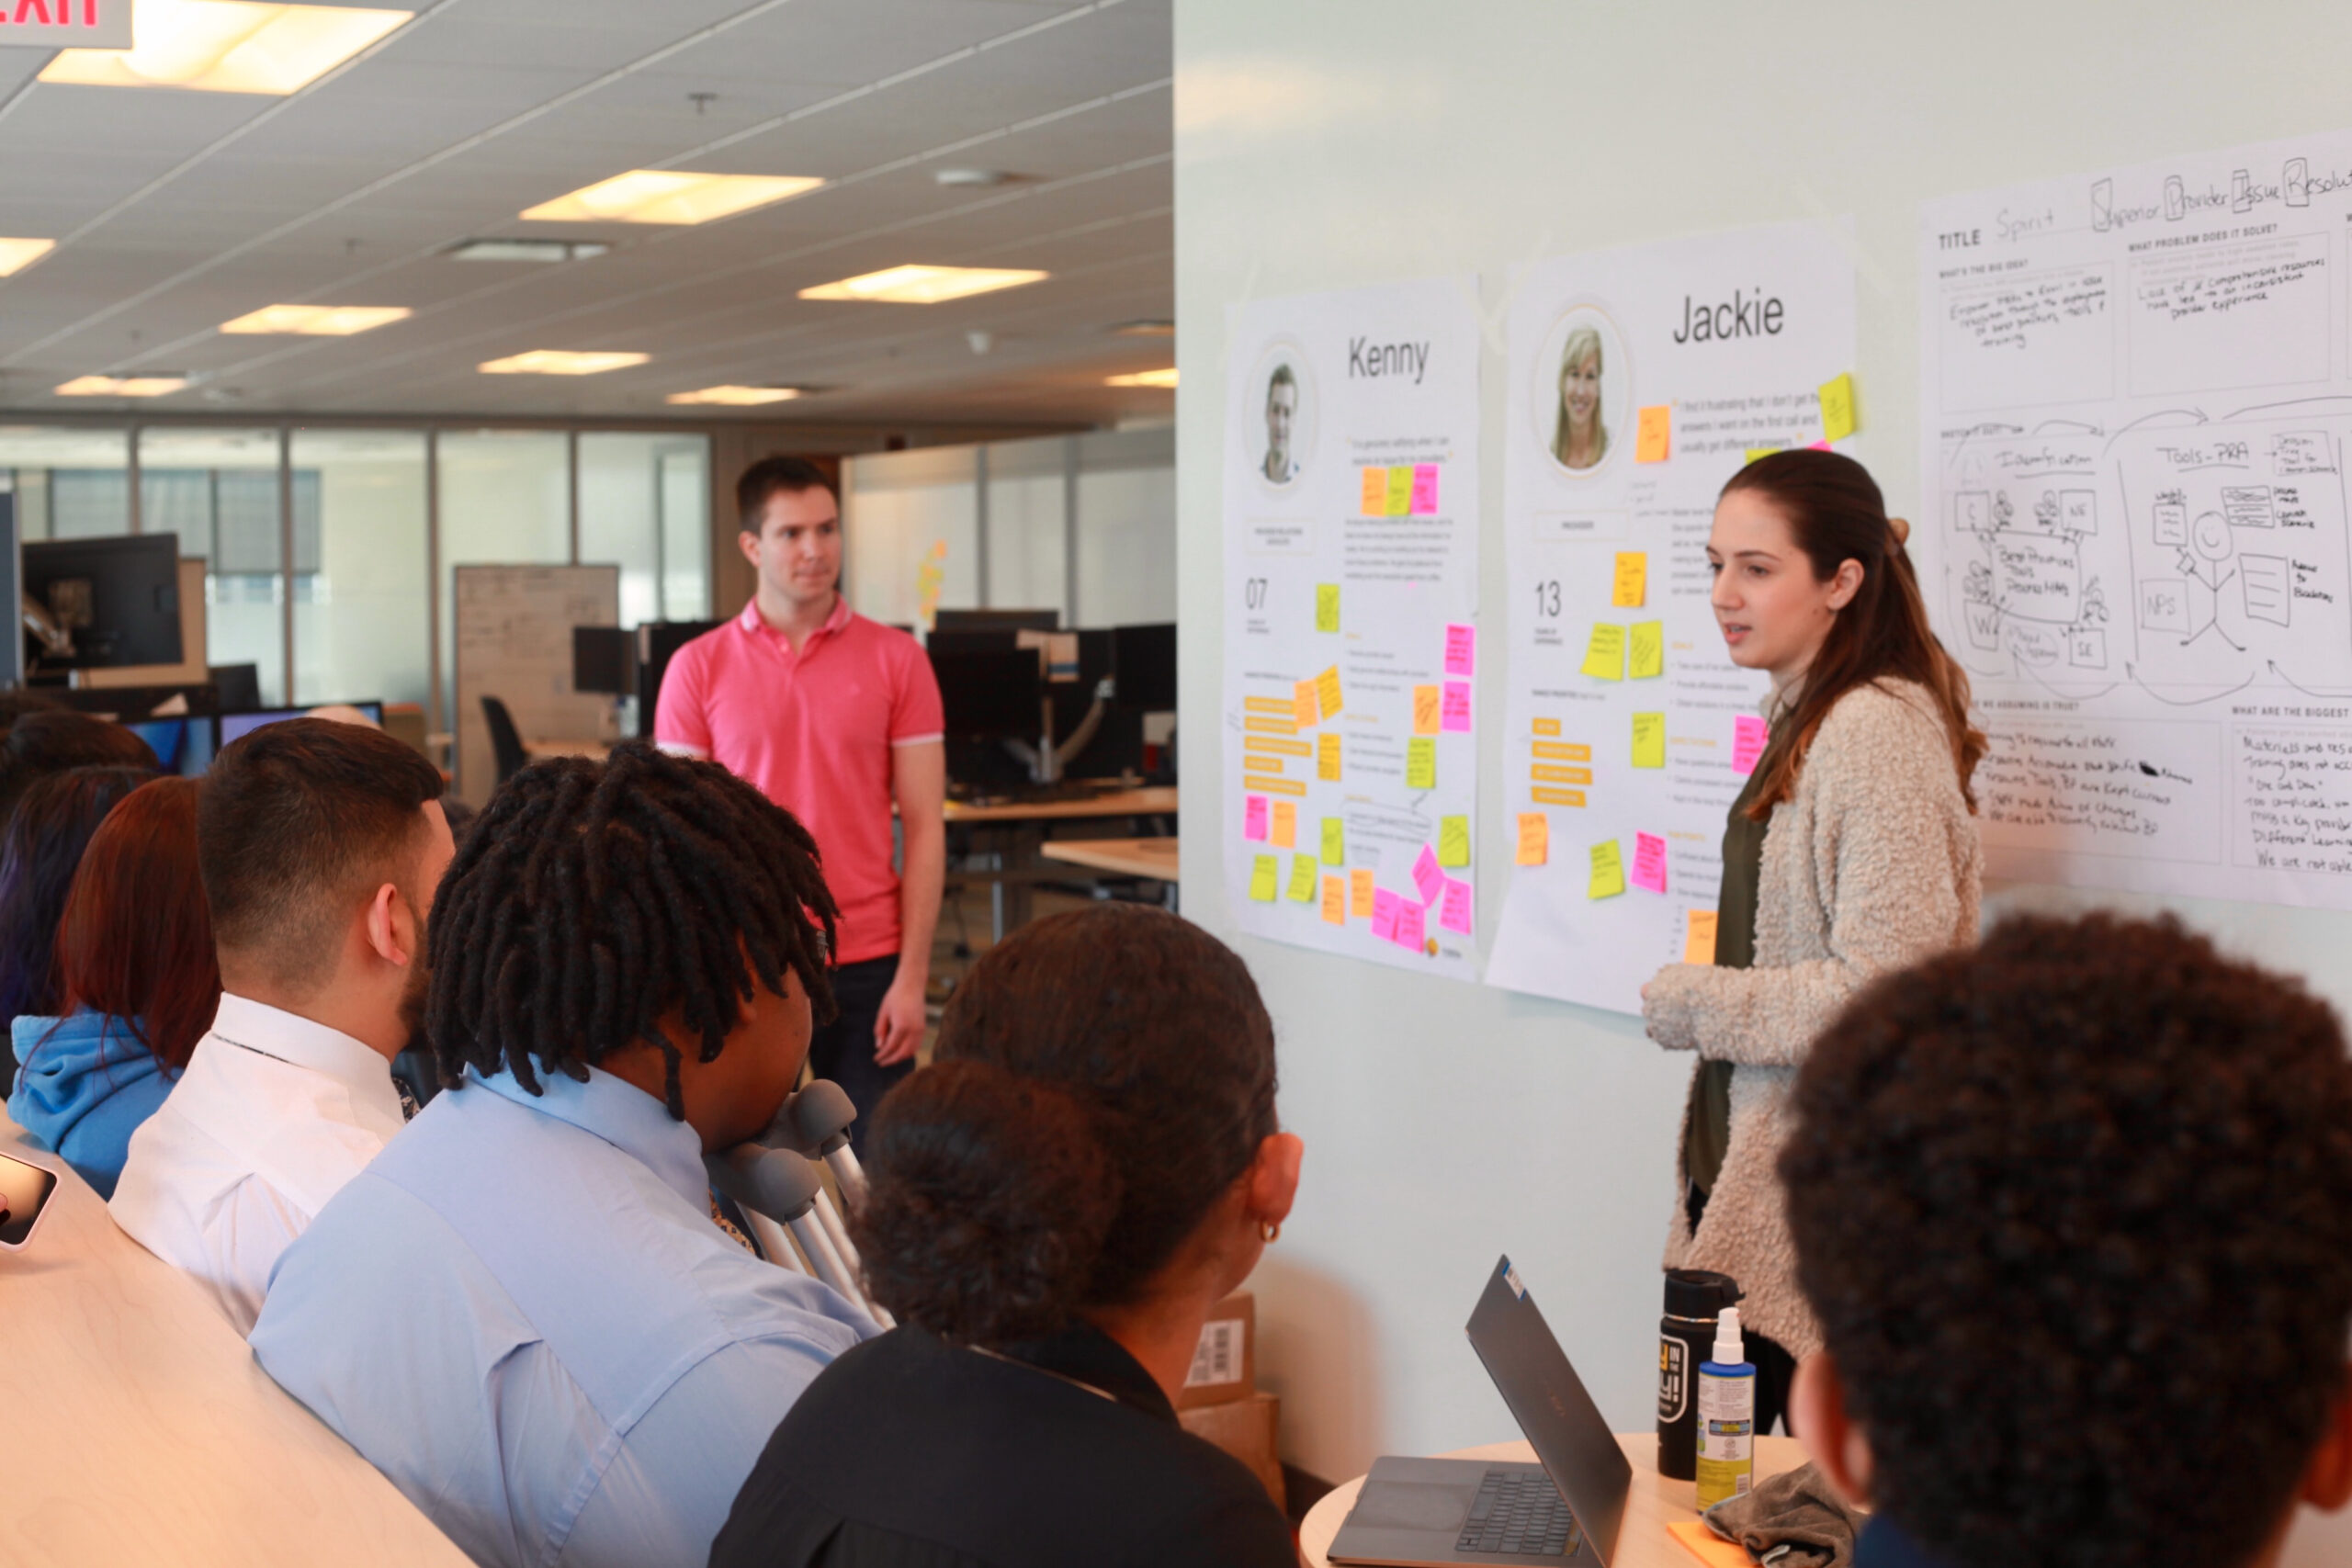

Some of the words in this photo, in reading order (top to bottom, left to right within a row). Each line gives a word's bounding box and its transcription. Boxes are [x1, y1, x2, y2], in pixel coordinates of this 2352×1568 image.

[0, 0, 98, 28] XI
[2165, 179, 2228, 217] Provider
[2233, 175, 2280, 204] Issue
[1939, 229, 1982, 250] TITLE
[1996, 208, 2054, 243] Spirit
[2129, 241, 2153, 253] WHAT
[2154, 234, 2199, 249] PROBLEM
[2202, 231, 2228, 243] DOES
[2231, 228, 2240, 239] IT
[2243, 222, 2278, 238] SOLVE?
[1673, 286, 1785, 345] Jackie
[1348, 335, 1430, 386] Kenny
[2155, 446, 2204, 465] Tools
[1245, 577, 1268, 610] 07
[1535, 580, 1562, 617] 13
[2232, 705, 2257, 716] WHAT
[2261, 705, 2280, 716] ARE
[2283, 705, 2301, 717] THE
[2304, 705, 2349, 718] BIGGEST
